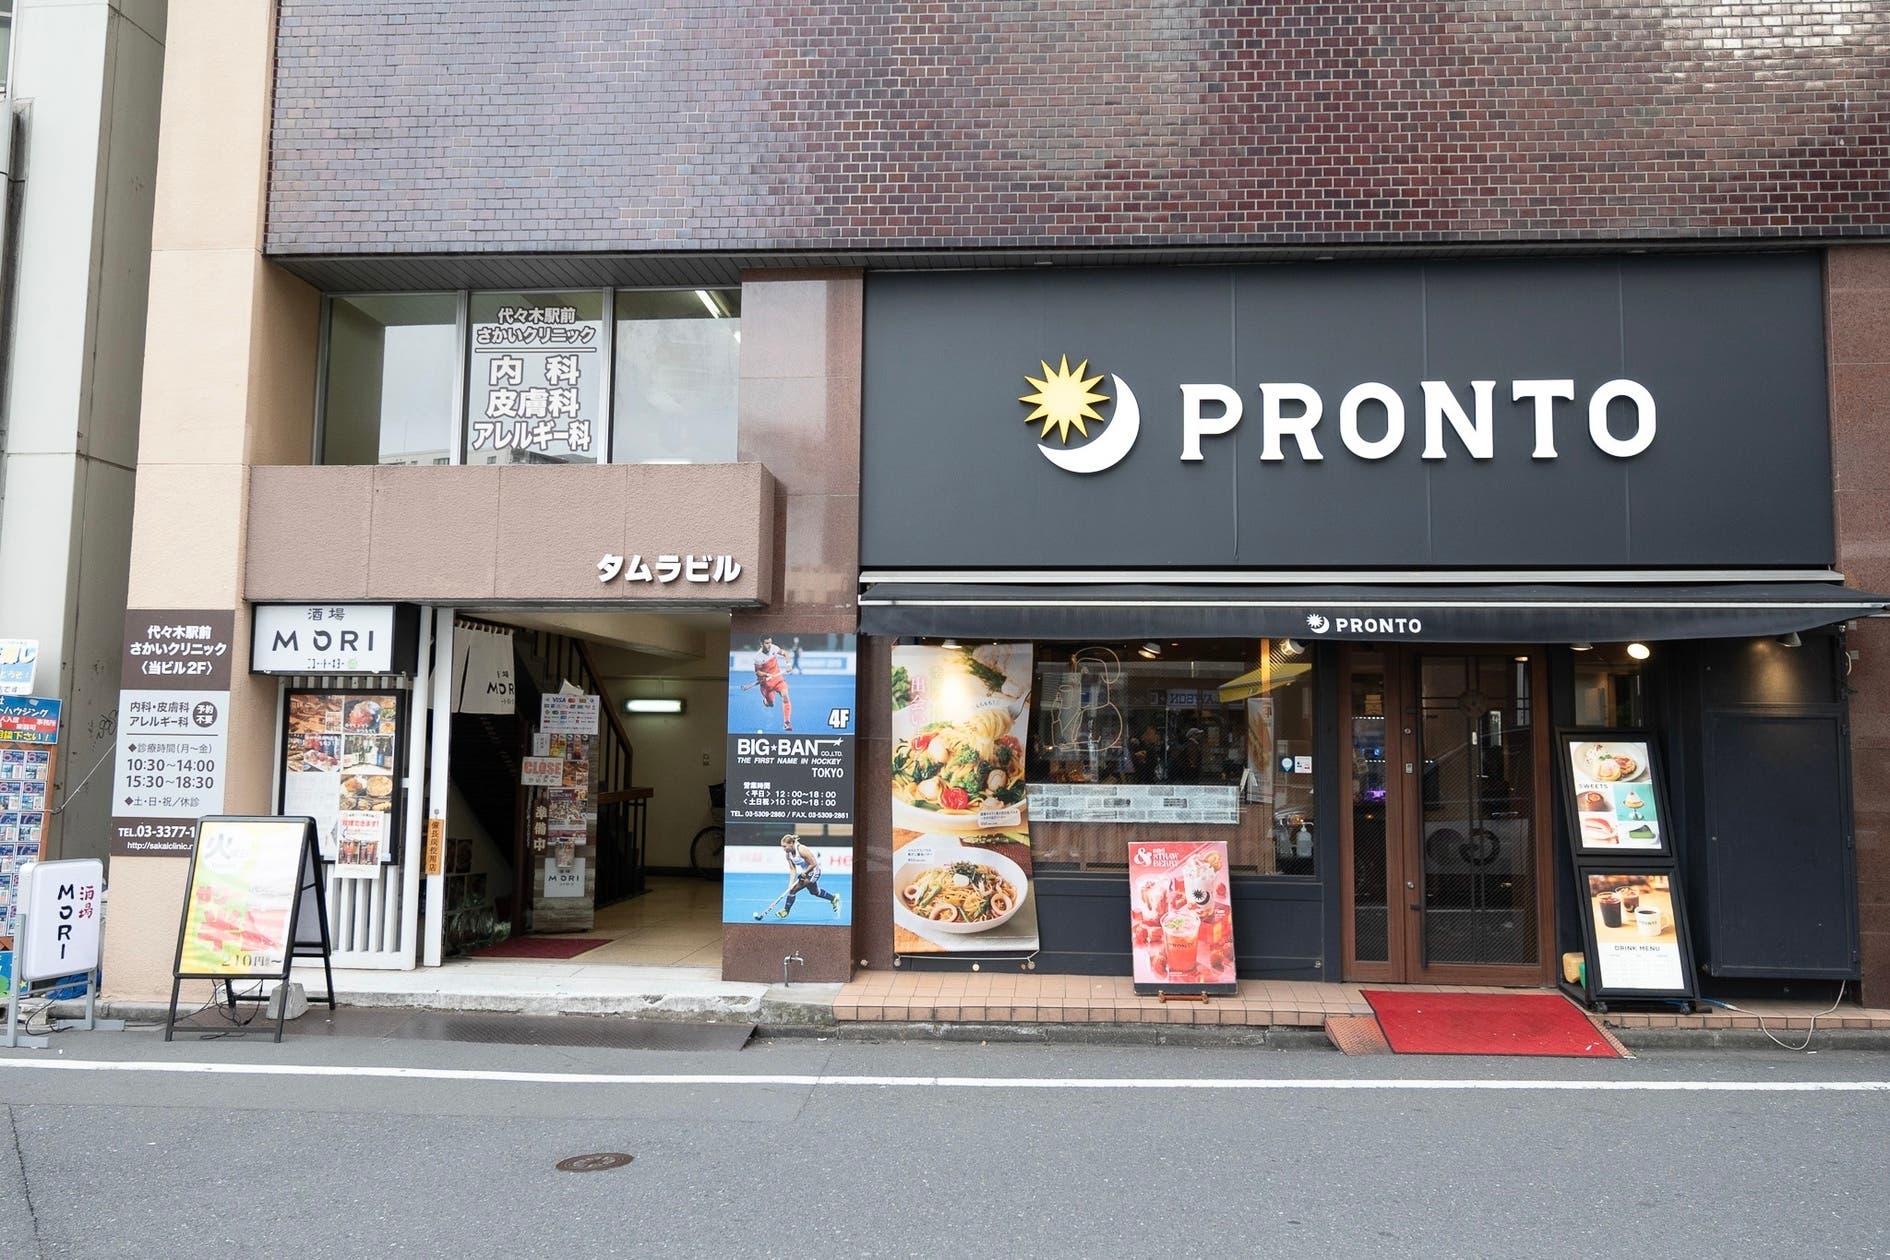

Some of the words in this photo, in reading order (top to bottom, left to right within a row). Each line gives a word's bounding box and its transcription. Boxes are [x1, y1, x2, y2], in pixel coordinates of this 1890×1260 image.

[498, 307, 576, 324] 代々木駅前
[477, 326, 596, 344] さかいクリニック
[489, 354, 581, 386] 内科
[485, 387, 580, 419] 皮膚科
[1180, 378, 1657, 461] PRONTO
[472, 420, 591, 451] アレルギー科
[596, 553, 742, 583] タムラビル
[308, 607, 345, 621] 酒場
[147, 625, 212, 640] 代々木駅前
[1335, 618, 1422, 634] PRONTO
[130, 642, 227, 656] さかいクリニック
[272, 630, 374, 652] MORI
[130, 701, 189, 713] 内科・皮膚科
[129, 716, 189, 727] アレルギー科
[828, 708, 850, 729] 4F
[524, 761, 562, 774] CLOSE
[737, 756, 751, 764] THE
[812, 767, 844, 778] TOKYO
